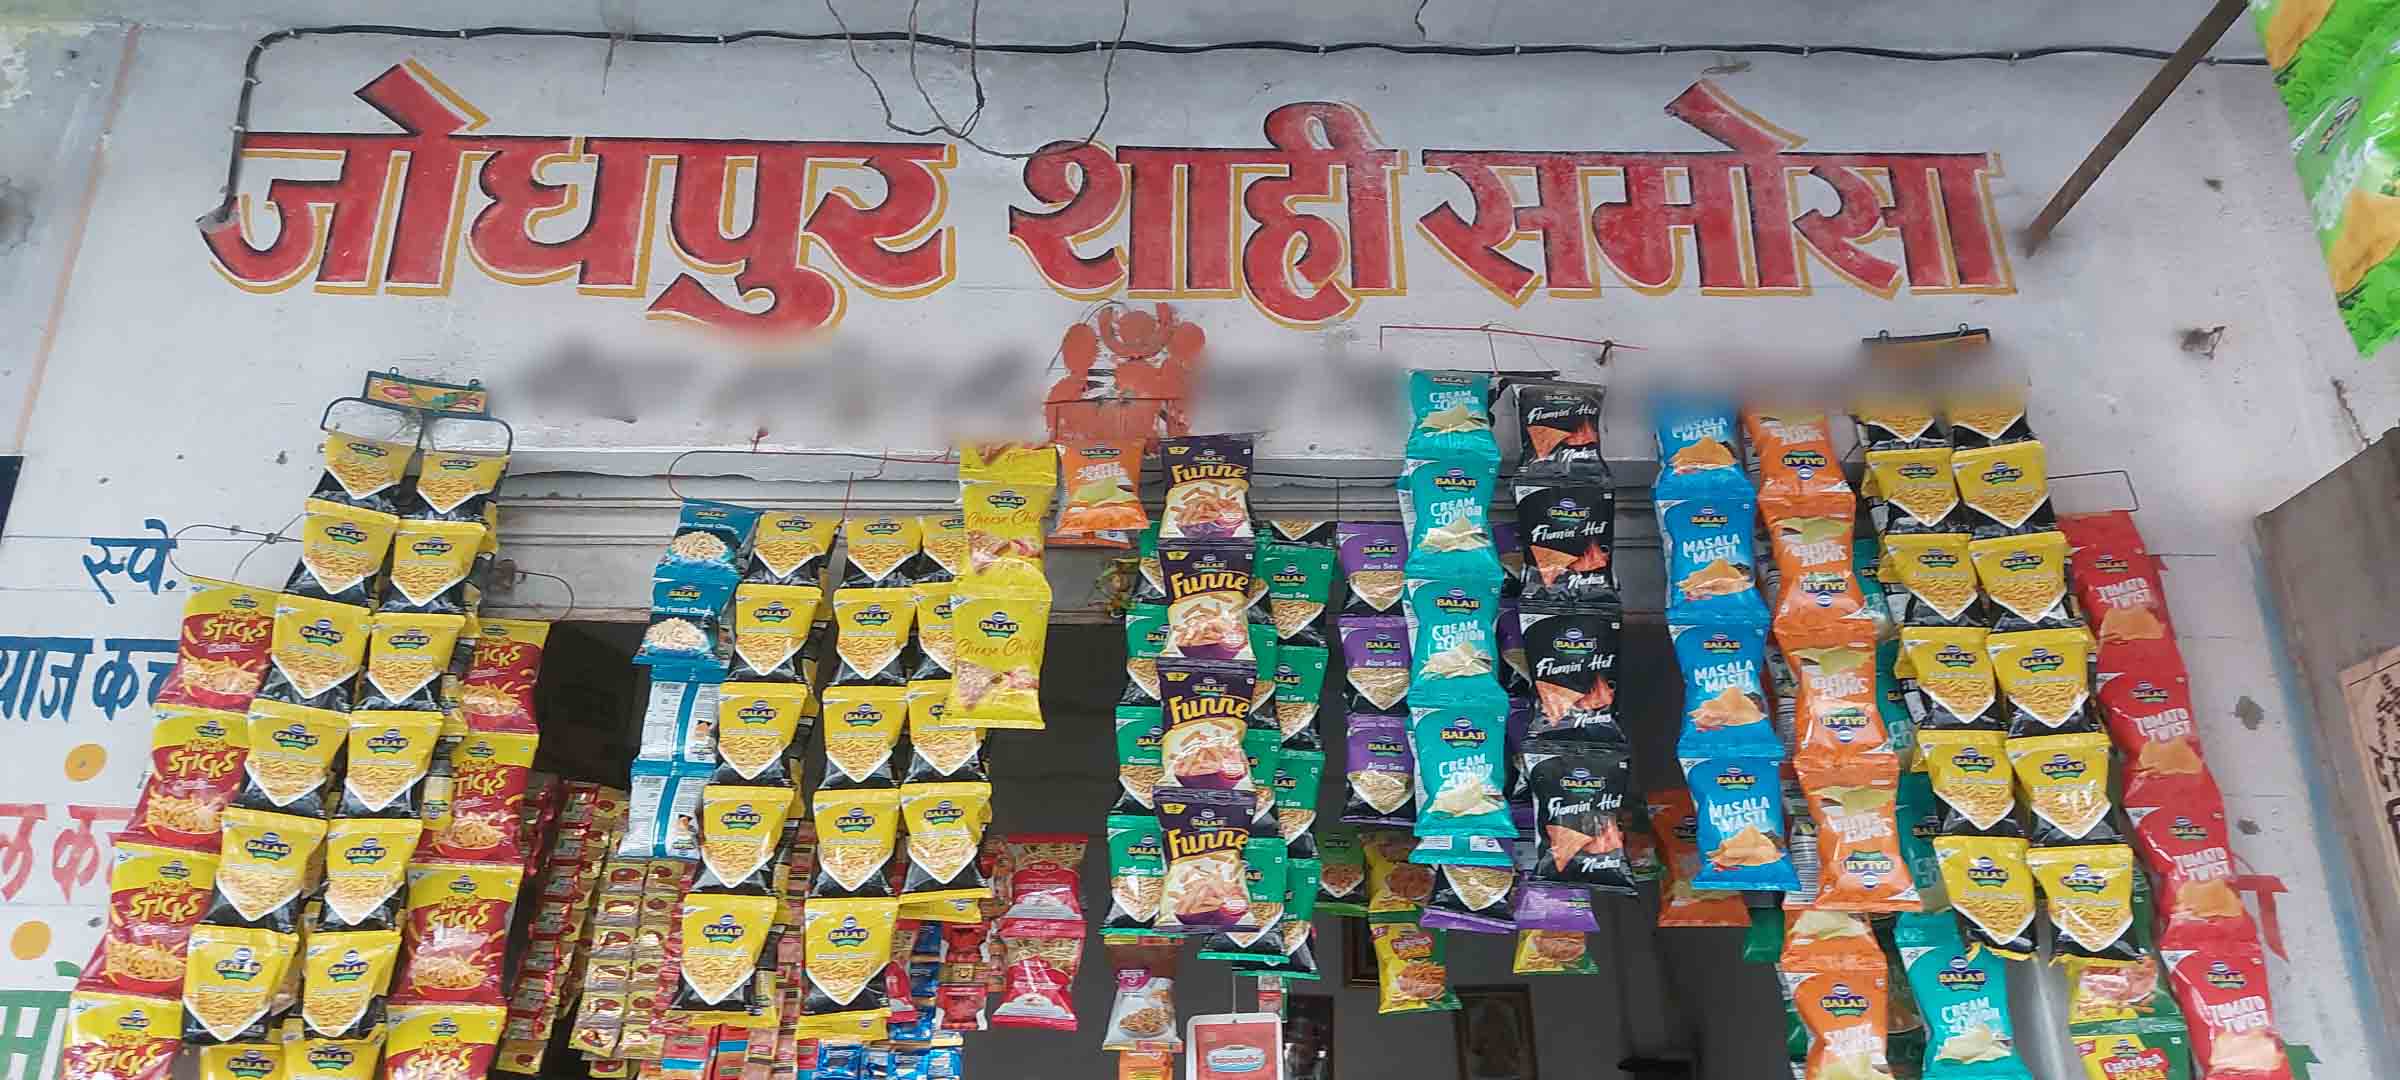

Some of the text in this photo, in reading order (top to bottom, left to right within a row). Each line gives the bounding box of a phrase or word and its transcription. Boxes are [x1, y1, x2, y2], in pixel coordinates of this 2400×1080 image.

[200, 58, 2017, 329] जोधपुर शाही समोसा
[1171, 463, 1248, 484] Funne
[1431, 497, 1475, 517] CREAM
[1683, 534, 1741, 557] MASALA
[1171, 571, 1249, 598] Funne
[203, 618, 267, 643] STICKS
[1432, 620, 1478, 641] CREAM
[474, 646, 521, 668] TICKS
[1695, 660, 1754, 685] MASALA
[1169, 696, 1250, 724] Funne
[2137, 708, 2189, 736] TOMATO
[2150, 721, 2192, 740] TWIST
[168, 751, 235, 778] STICKS
[1439, 753, 1487, 779] CREAM
[455, 769, 508, 797] TICKS
[1709, 796, 1770, 824] MASALA
[1167, 828, 1249, 861] Funne
[2172, 847, 2227, 878] TOMATO
[2188, 862, 2231, 880] TWIST
[128, 894, 202, 923] STICKS
[1941, 997, 1990, 1024] CREAM
[2207, 995, 2265, 1025] TOMATO
[2223, 1012, 2269, 1033] TWIST
